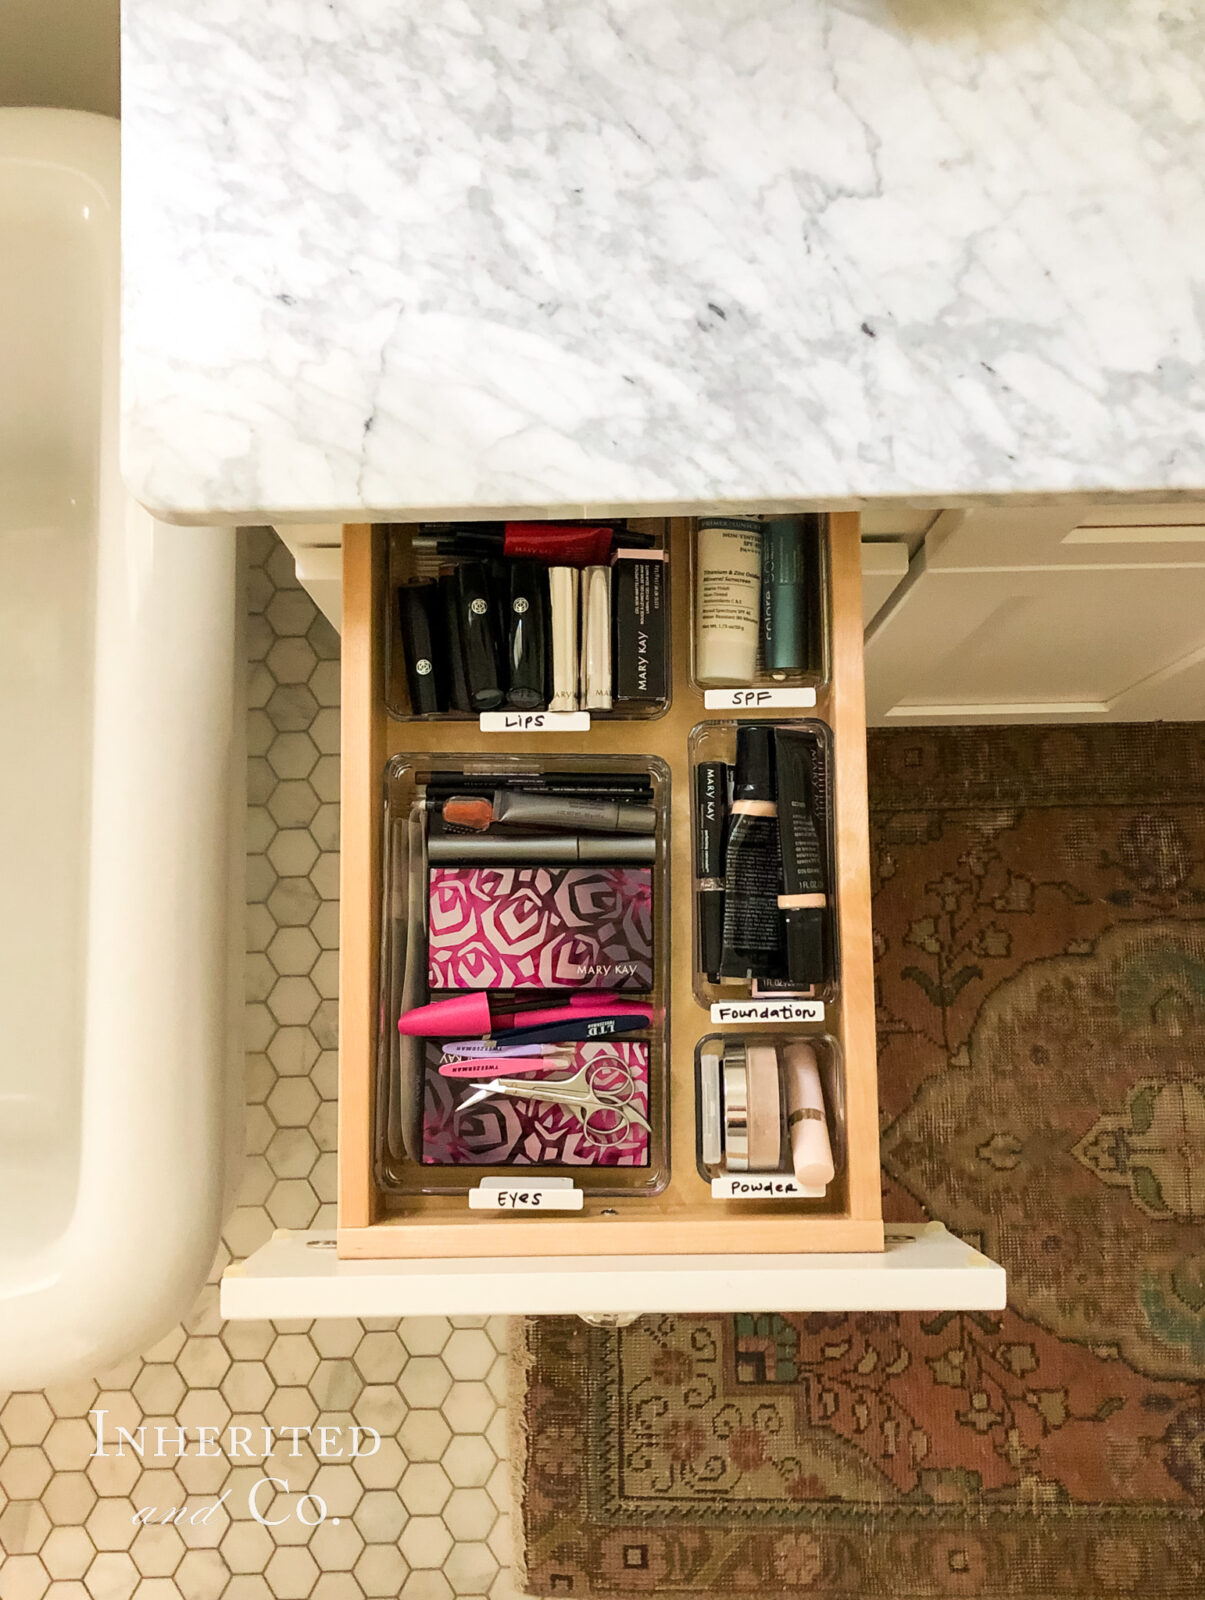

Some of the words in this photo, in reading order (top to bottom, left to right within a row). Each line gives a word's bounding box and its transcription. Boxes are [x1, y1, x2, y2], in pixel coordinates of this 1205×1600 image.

[637, 630, 649, 654] KAY
[637, 656, 649, 691] MARY
[554, 691, 572, 699] ARY
[595, 689, 610, 697] MA
[732, 692, 772, 705] SPF
[705, 768, 715, 799] MARY
[705, 801, 715, 822] KAY
[576, 963, 611, 977] MARY
[615, 963, 638, 977] KAY
[719, 1004, 816, 1020] Foundation
[588, 1024, 615, 1037] LTD
[439, 1053, 462, 1064] KAY
[452, 1064, 499, 1073] TWEEZERMAN
[498, 1191, 543, 1208] Eyes
